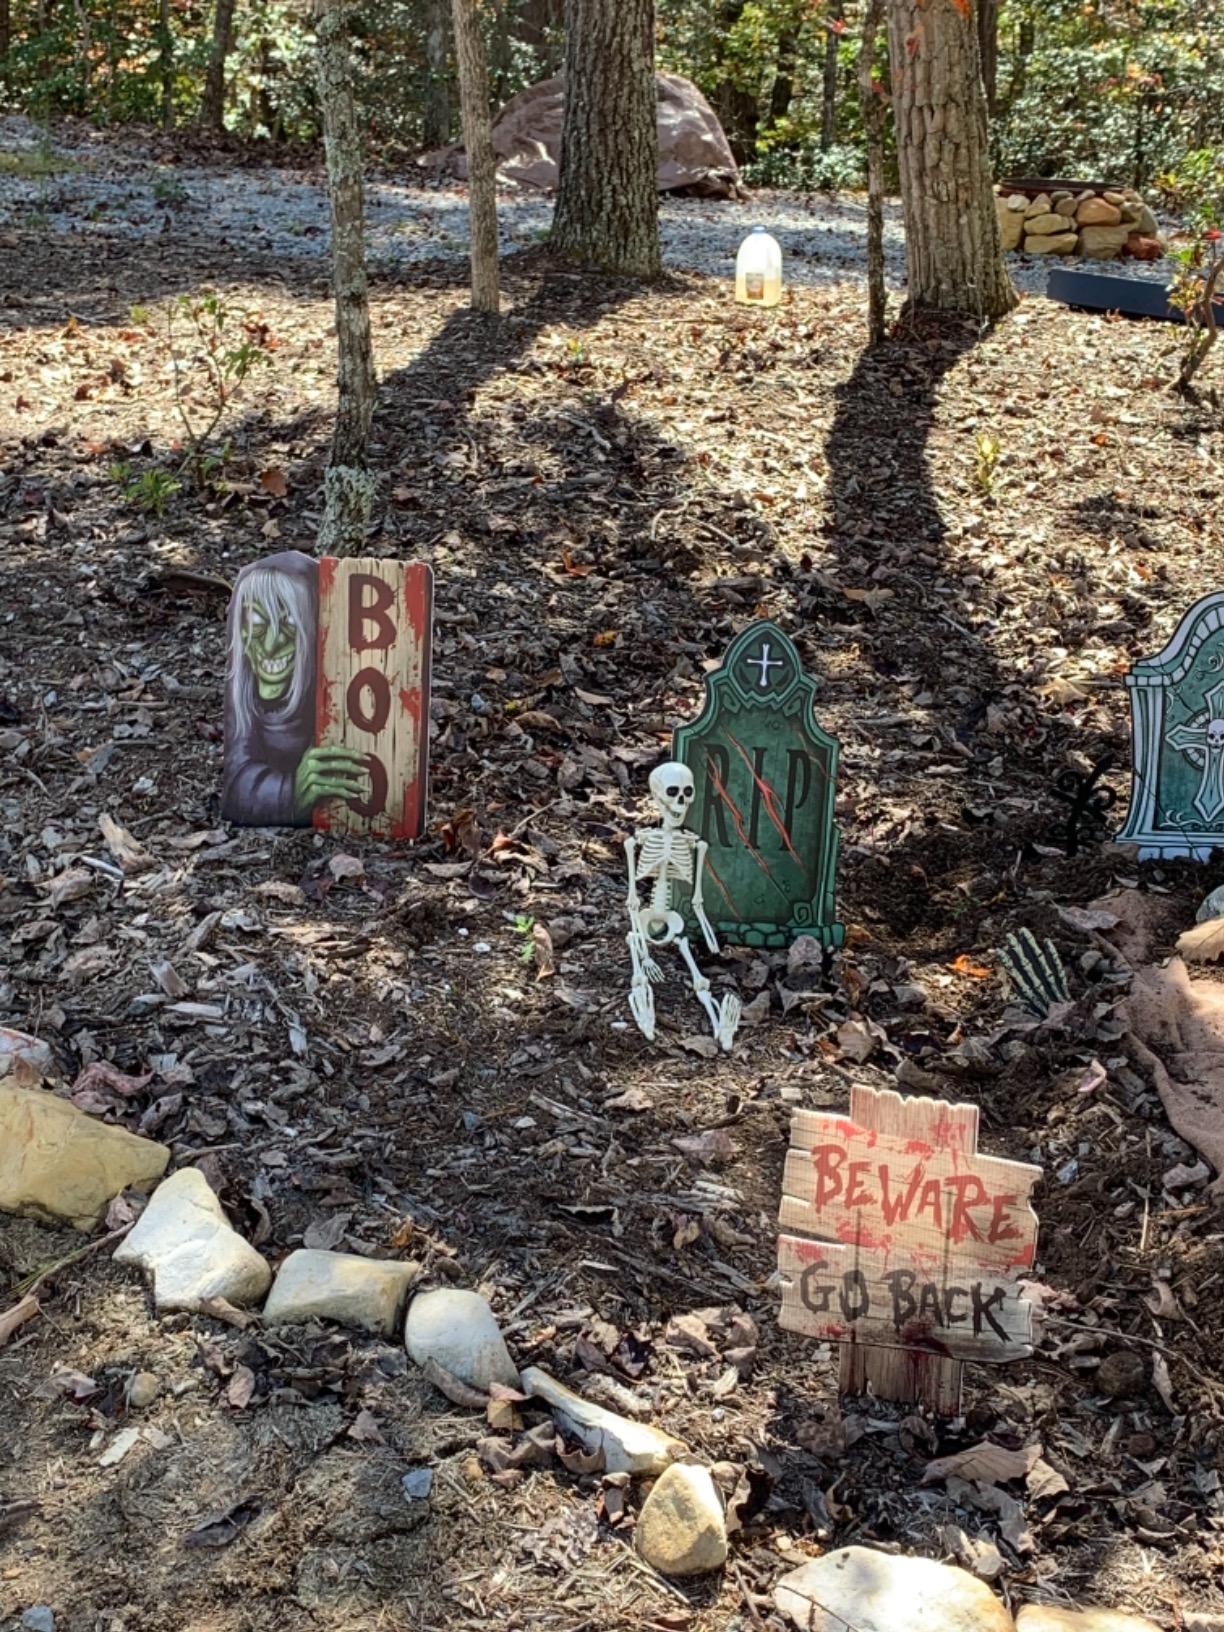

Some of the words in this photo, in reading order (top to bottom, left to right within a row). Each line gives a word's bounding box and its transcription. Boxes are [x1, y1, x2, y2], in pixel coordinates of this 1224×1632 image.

[702, 743, 812, 850] RIP
[811, 1144, 1024, 1244] BEWARE
[800, 1260, 869, 1322] GO
[881, 1268, 1013, 1343] BACK
